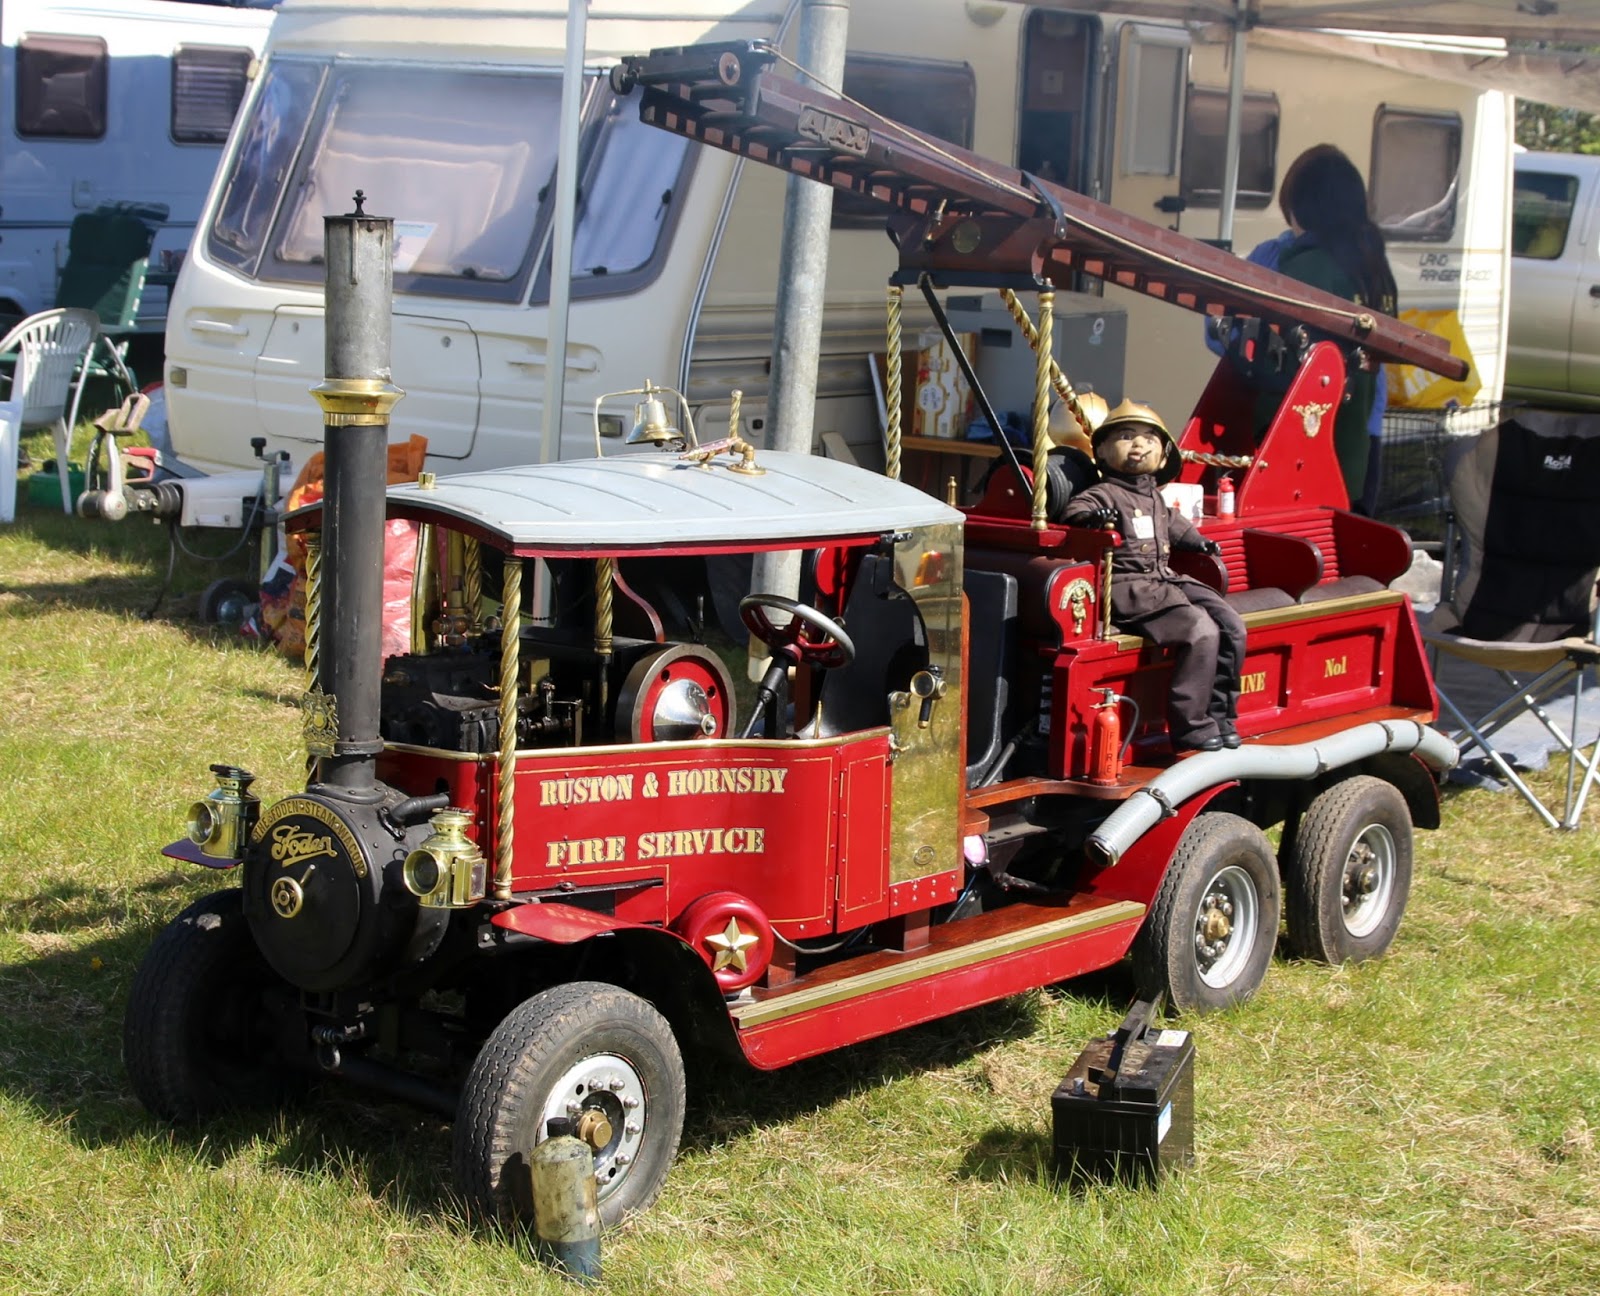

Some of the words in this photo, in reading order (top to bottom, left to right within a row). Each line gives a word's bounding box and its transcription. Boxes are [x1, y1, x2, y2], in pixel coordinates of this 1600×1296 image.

[1420, 253, 1448, 267] LAND
[1240, 671, 1266, 695] INE
[540, 774, 634, 806] RUSTON
[642, 772, 659, 798] &
[667, 767, 788, 797] HORNSBY
[273, 800, 299, 819] FODEN
[305, 802, 336, 827] STEAM
[546, 836, 626, 867] FIRE
[637, 828, 765, 860] SERVICE
